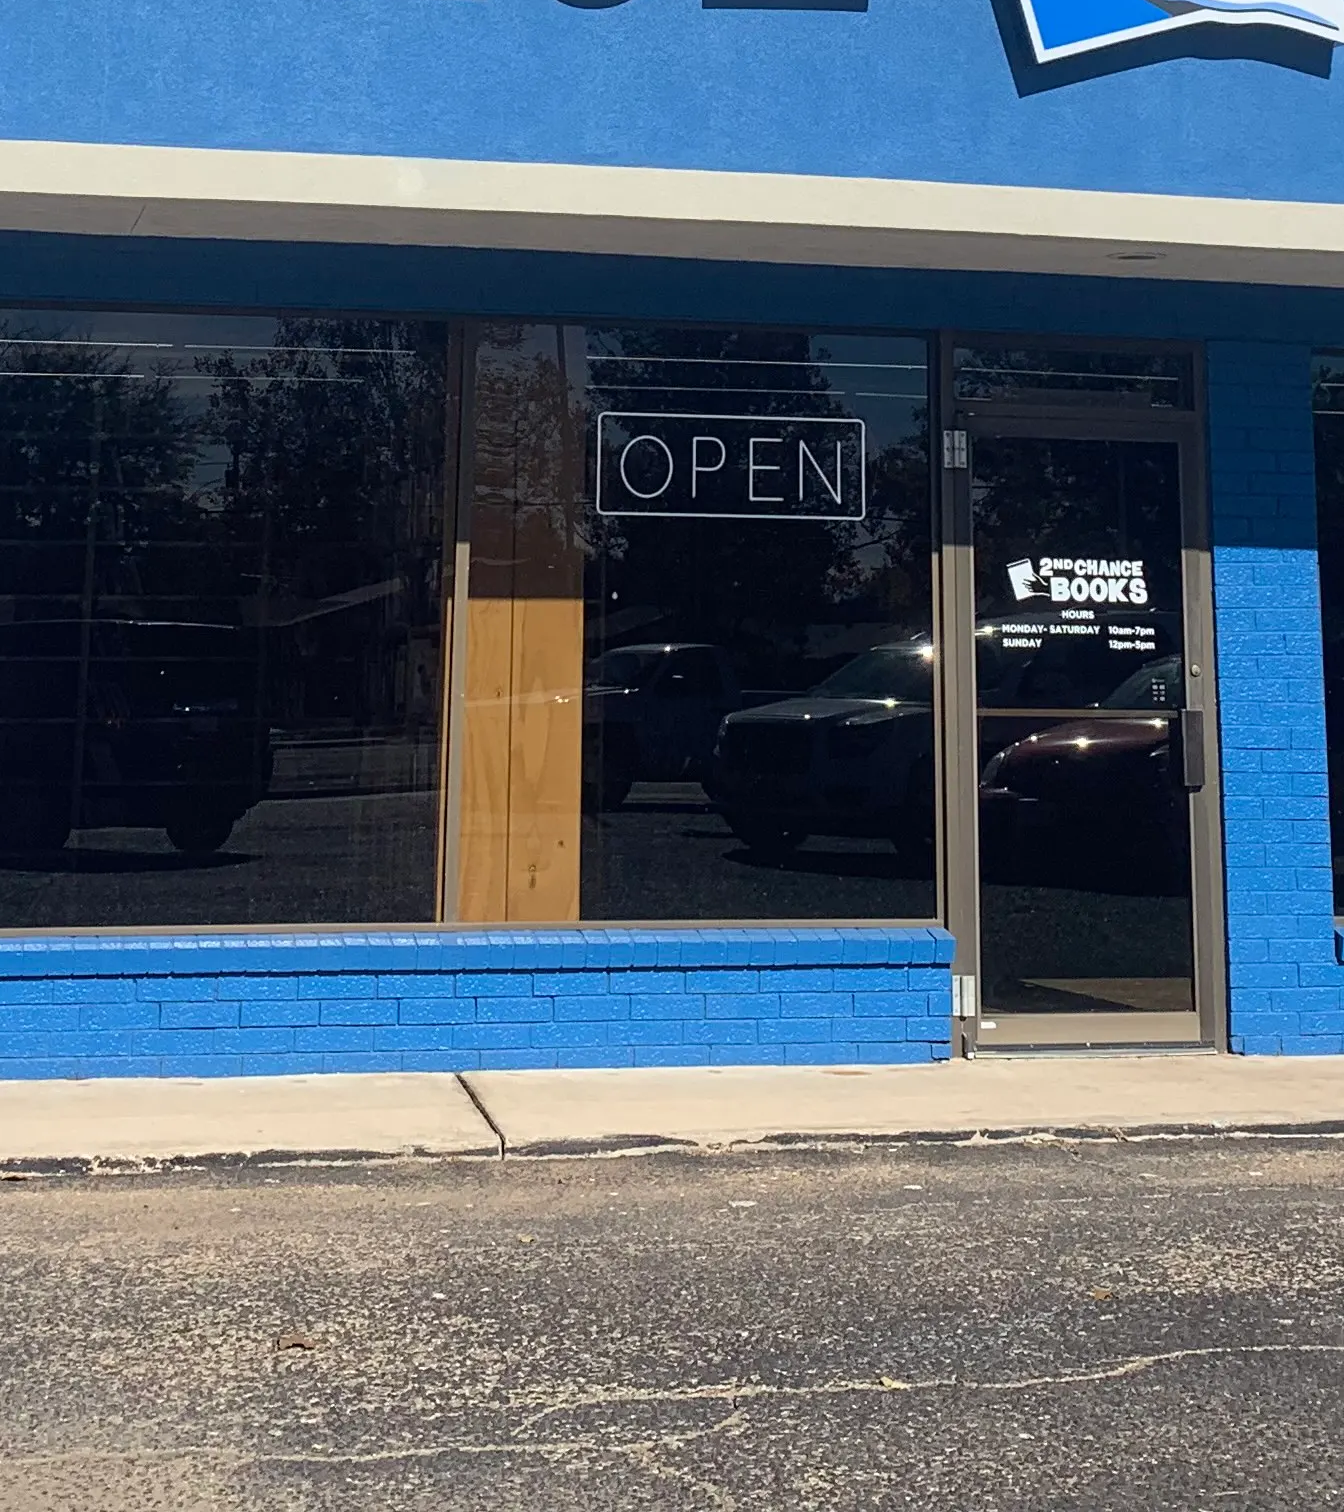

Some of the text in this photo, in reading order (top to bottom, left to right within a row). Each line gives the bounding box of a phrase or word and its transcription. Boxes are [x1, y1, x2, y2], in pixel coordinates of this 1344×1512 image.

[620, 435, 843, 506] OPEN
[1039, 557, 1144, 577] 2ND CHANCE
[1050, 577, 1149, 605] BOOKS
[1061, 609, 1095, 620] HOURS
[1049, 625, 1101, 635] SATURDAY
[1108, 626, 1155, 636] 10am-7pm
[1002, 638, 1042, 648] SUNDAY
